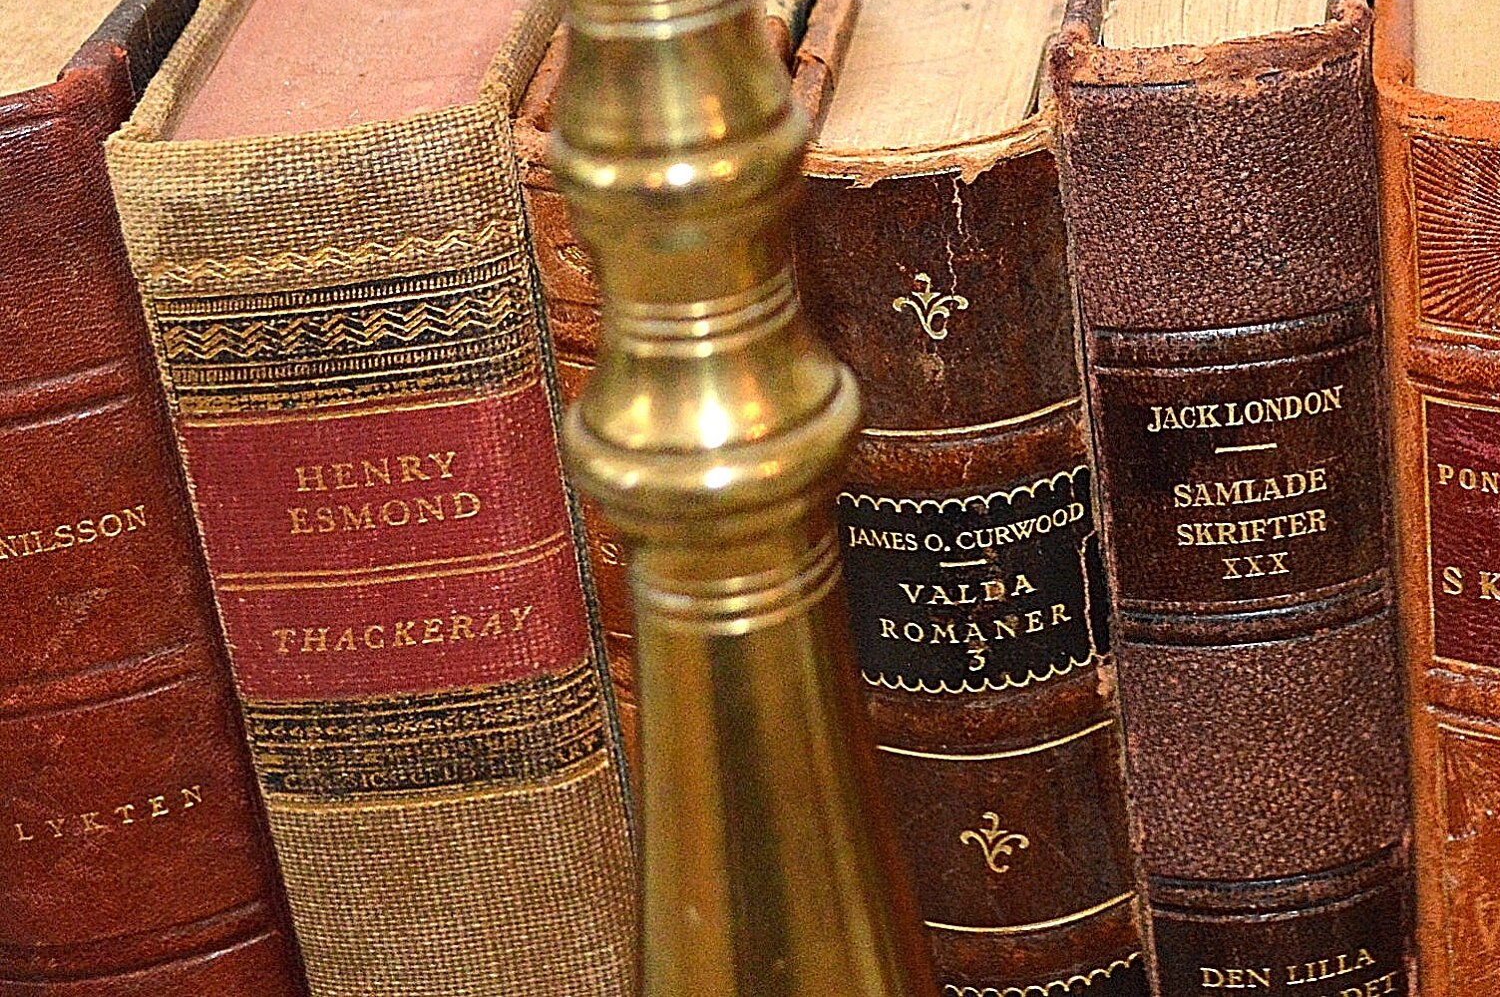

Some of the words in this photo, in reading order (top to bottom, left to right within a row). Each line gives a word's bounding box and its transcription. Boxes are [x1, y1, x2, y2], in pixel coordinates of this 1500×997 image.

[1147, 404, 1222, 432] JACK
[1224, 385, 1344, 427] LONDON
[295, 452, 456, 491] HENRY
[1174, 468, 1327, 507] SAMLADE
[0, 505, 147, 559] NILSSON
[288, 492, 480, 534] ESMOND
[848, 526, 918, 551] JAMES
[924, 534, 951, 551] O.
[956, 503, 1084, 549] CURWOOD
[1176, 509, 1327, 546] SKRIFTER
[899, 574, 1037, 605] VALDA
[272, 605, 533, 652] THACKERAY
[879, 604, 1071, 644] ROMANER
[966, 649, 986, 671] 3
[14, 785, 203, 841] LYKTEN
[1199, 967, 1271, 988] DEN
[1286, 948, 1376, 985] LILLA
